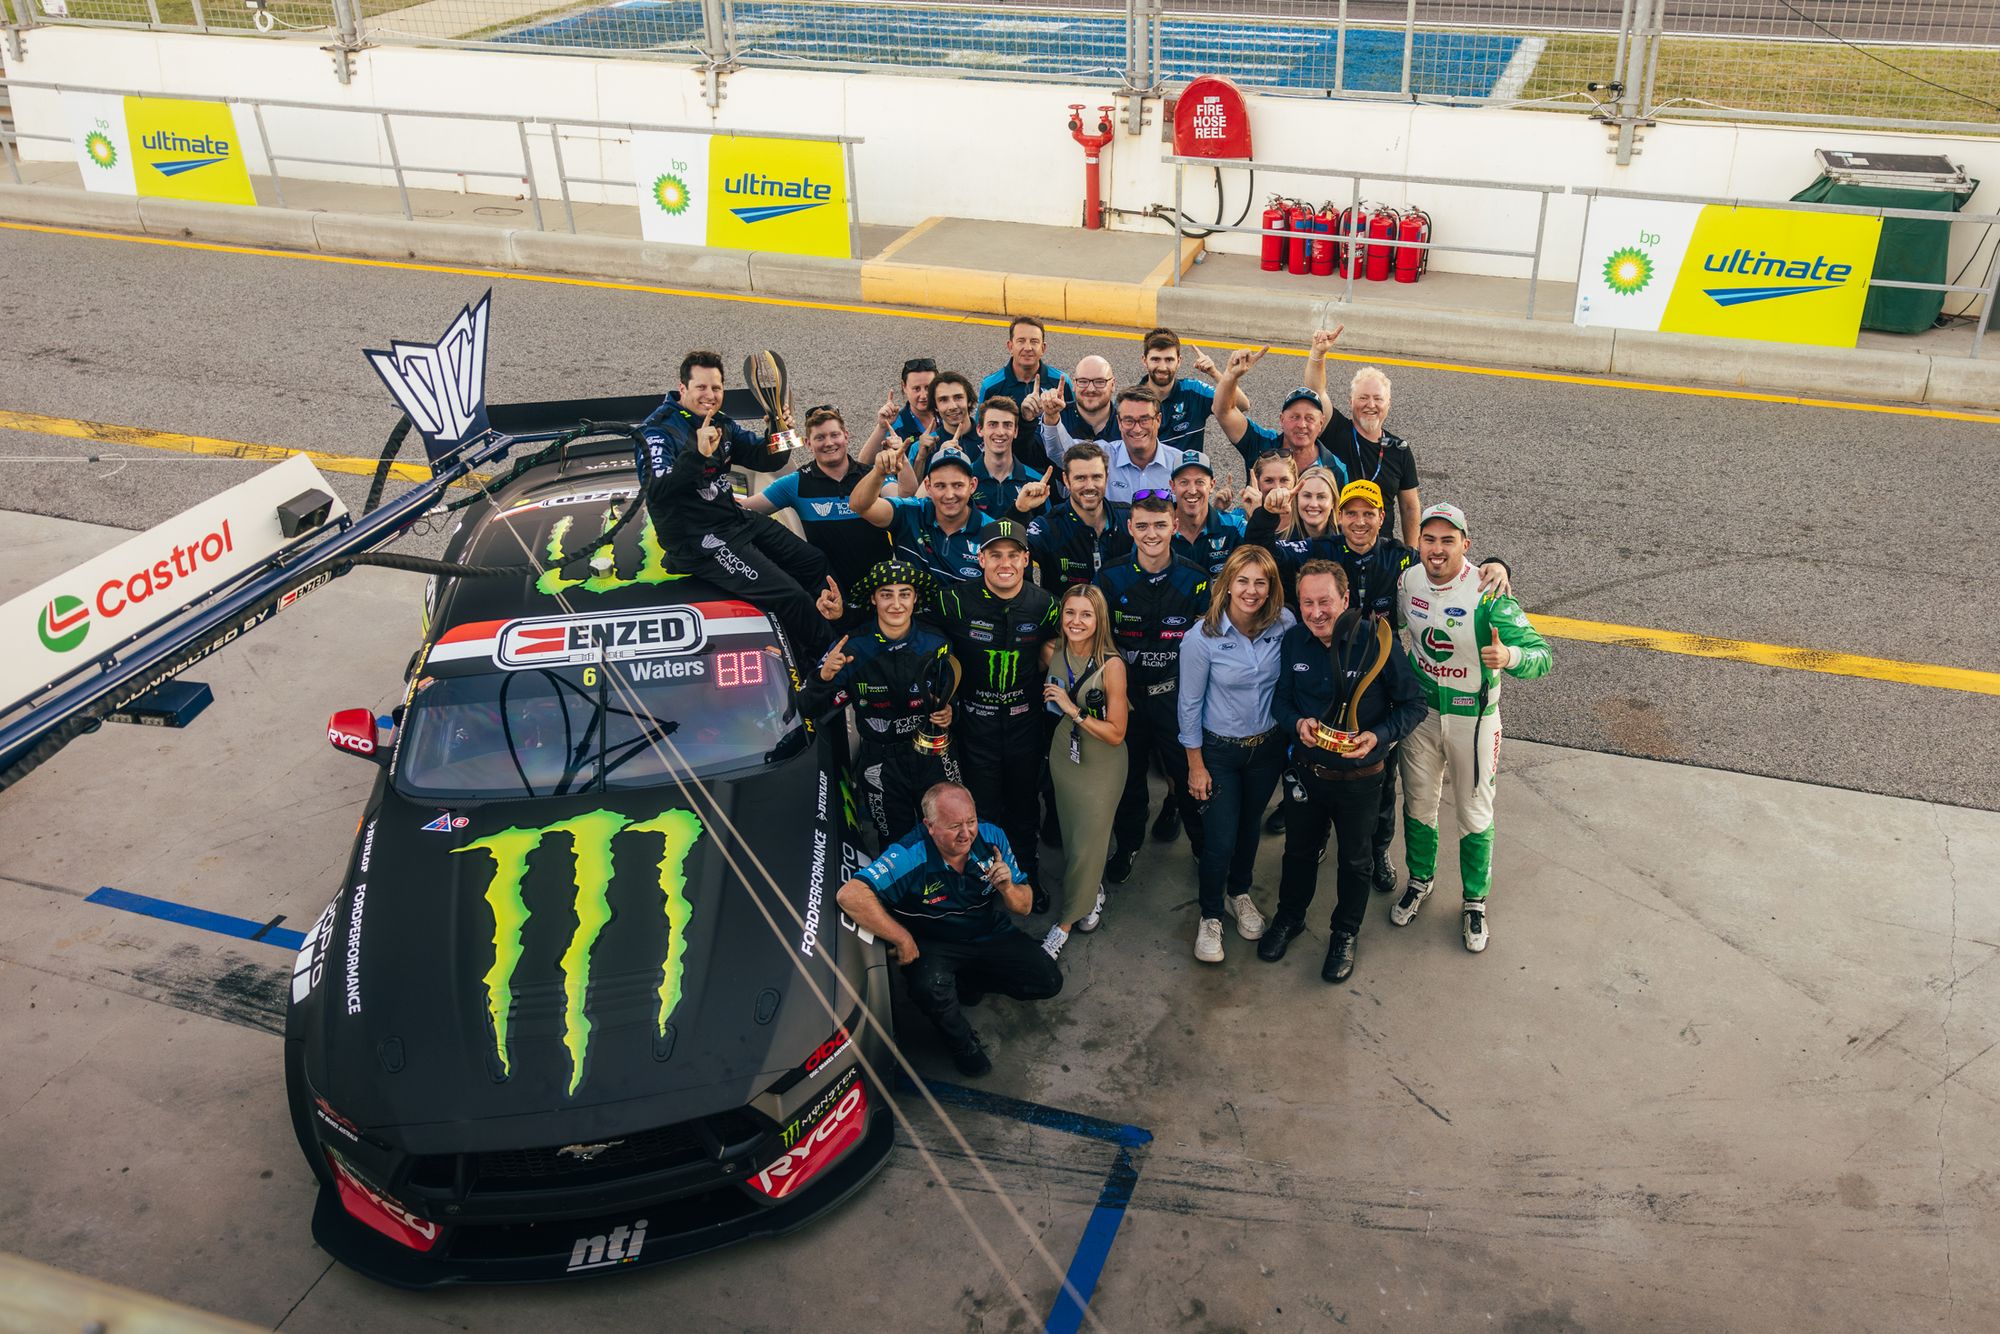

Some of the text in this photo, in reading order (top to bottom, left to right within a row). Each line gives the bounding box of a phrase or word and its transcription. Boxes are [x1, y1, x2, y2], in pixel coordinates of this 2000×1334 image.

[94, 117, 109, 130] bp
[1193, 116, 1227, 128] HOSE
[1197, 104, 1223, 116] FIRE
[142, 130, 229, 157] ultimate
[1195, 127, 1226, 139] REEL
[672, 158, 688, 174] bp
[724, 173, 831, 200] ultimate
[1639, 230, 1661, 248] bp
[1703, 249, 1851, 283] ultimate
[96, 519, 233, 618] Castrol
[244, 608, 269, 632] BY
[296, 573, 327, 599] ENZED
[567, 617, 686, 650] ENZED
[583, 667, 597, 686] 6
[629, 661, 705, 682] Waters
[1418, 657, 1467, 678] Castrol
[328, 728, 373, 752] RYCO
[817, 770, 828, 815] DUNLOP
[361, 828, 375, 873] DUNLOP
[801, 829, 828, 957] FORDPERFORMANCE
[347, 884, 367, 1015] FORDPERFORMANCE
[758, 1088, 861, 1193] RYCO
[568, 1219, 648, 1267] nti
